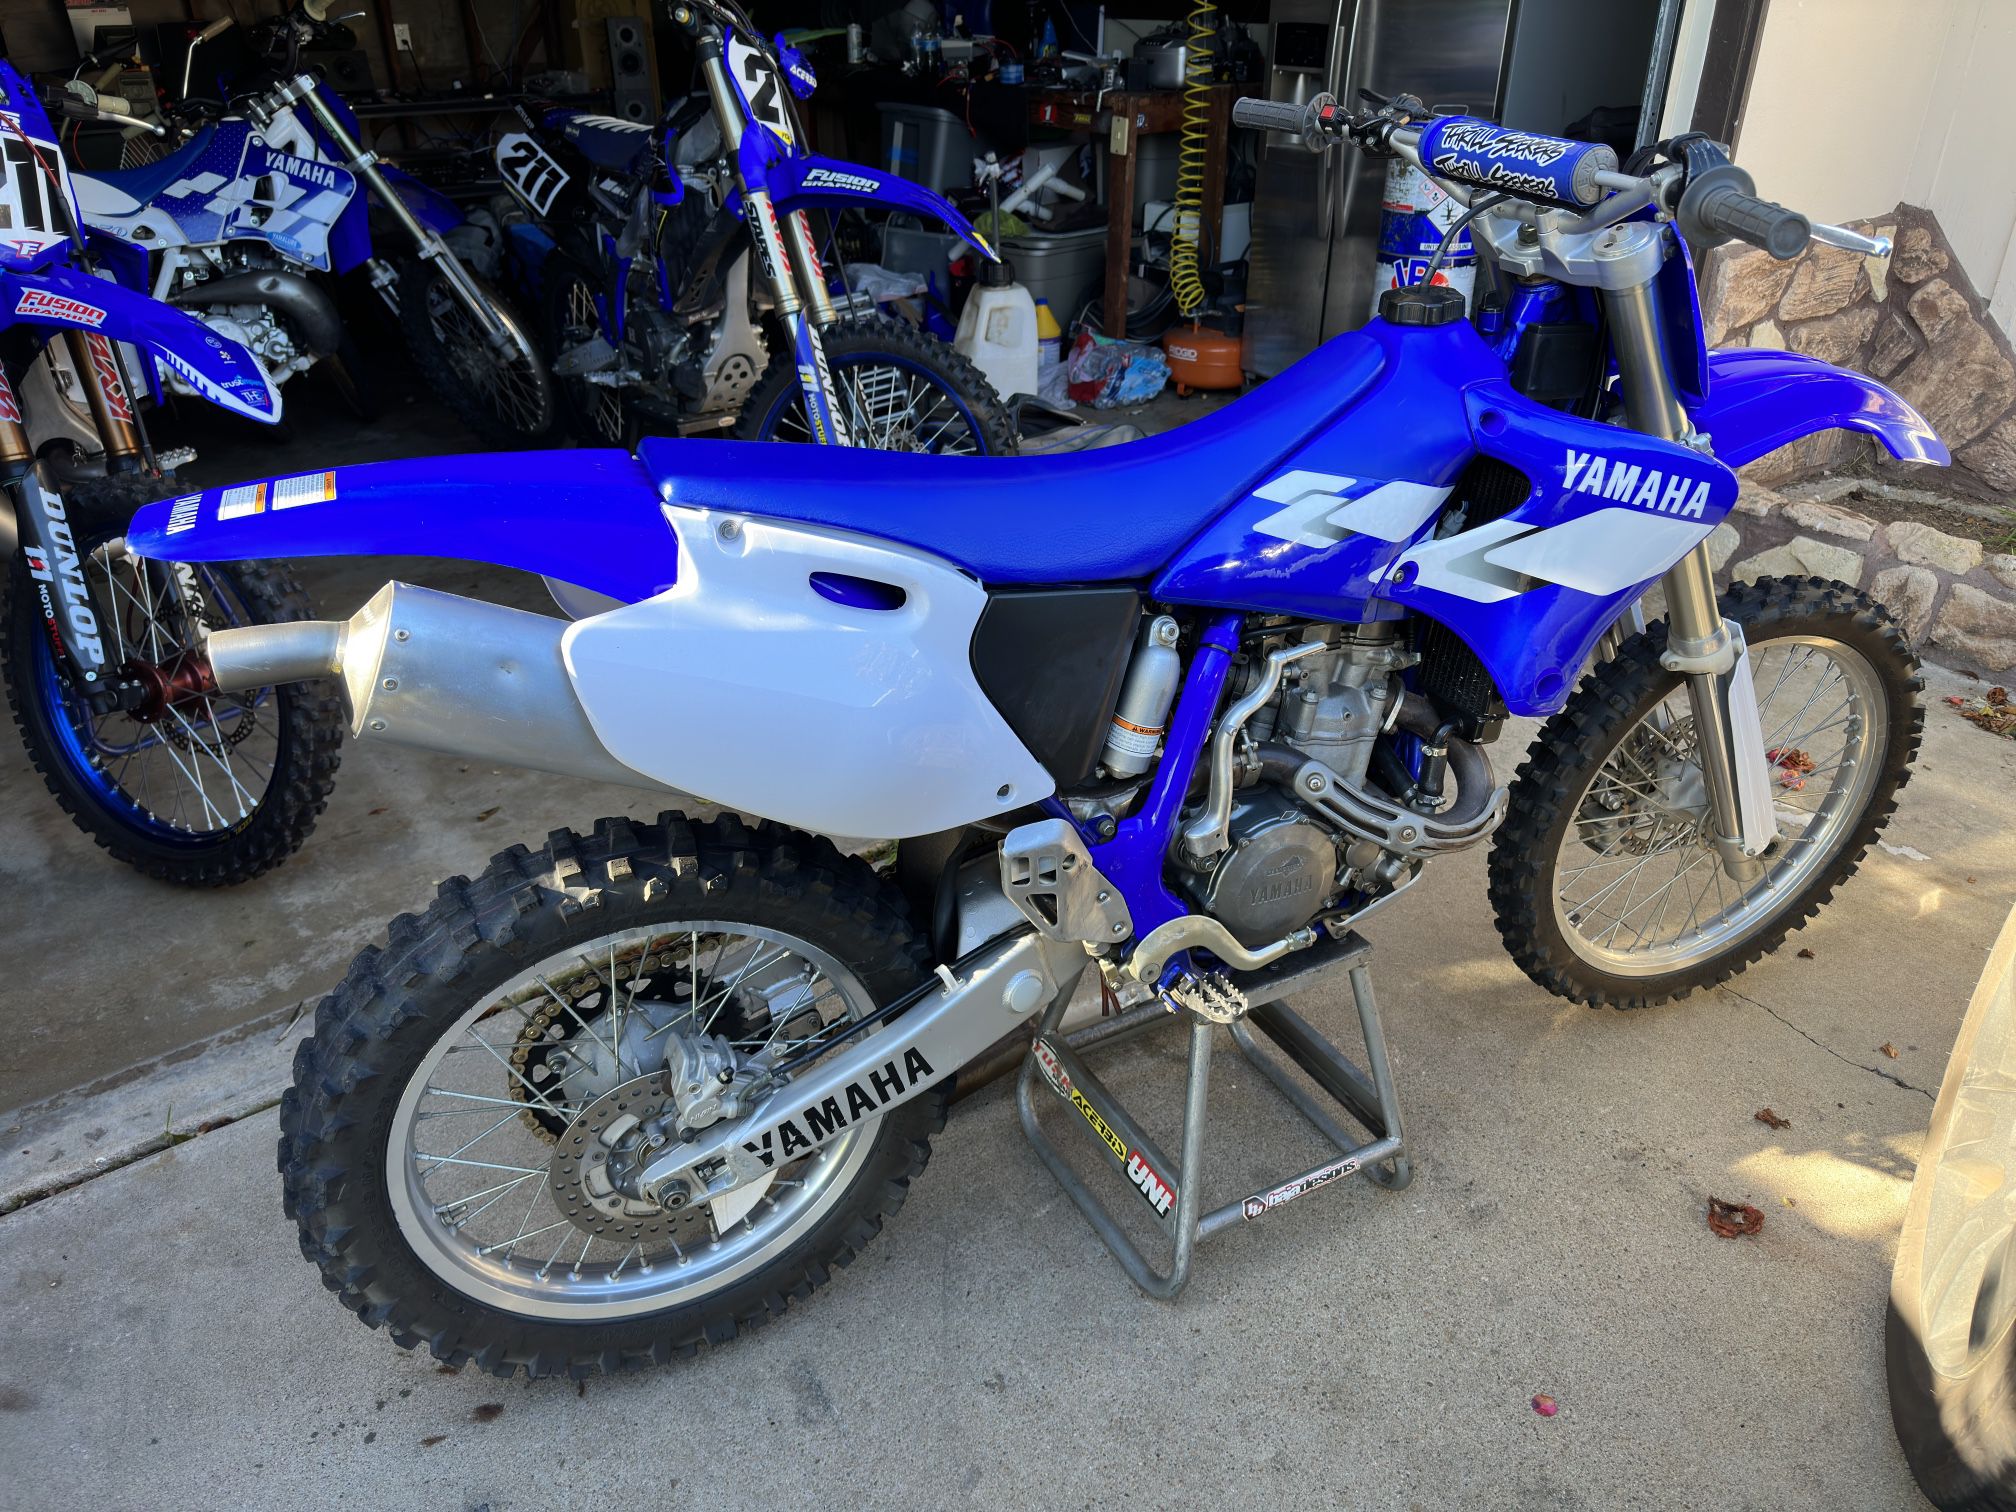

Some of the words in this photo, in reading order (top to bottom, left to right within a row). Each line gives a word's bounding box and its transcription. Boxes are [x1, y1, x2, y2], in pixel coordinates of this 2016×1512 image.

[264, 150, 337, 189] YAMAHA
[801, 180, 874, 194] GRAPHIX
[806, 167, 881, 190] FUSION
[16, 306, 97, 326] GRAPHIX
[21, 290, 106, 321] FUSION
[807, 392, 828, 446] MOTOSTUF
[1561, 448, 1711, 520] YAMAHA
[165, 493, 204, 536] YAMAHA
[38, 485, 106, 666] DUNLOP
[1250, 874, 1313, 907] YAMAHA
[742, 1046, 935, 1168] YAMAHA
[1073, 1095, 1125, 1157] ACERBIS
[1126, 1154, 1174, 1217] UNI
